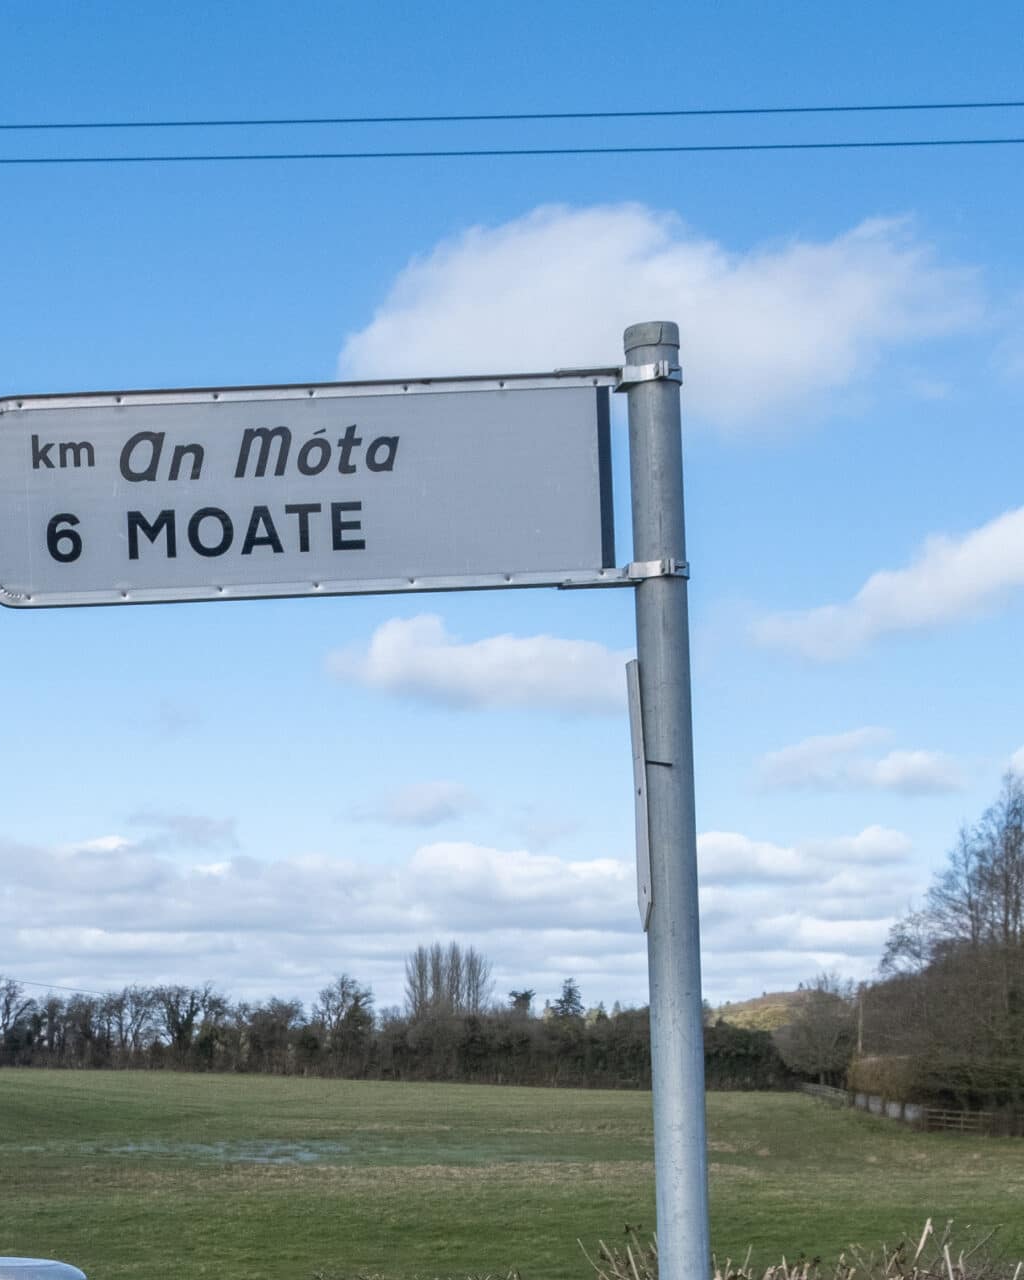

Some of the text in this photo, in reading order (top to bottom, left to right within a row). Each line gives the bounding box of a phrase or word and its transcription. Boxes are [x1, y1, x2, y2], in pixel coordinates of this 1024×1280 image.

[31, 434, 95, 469] km
[235, 424, 401, 477] Móta
[46, 501, 368, 562] 6 MOATE
